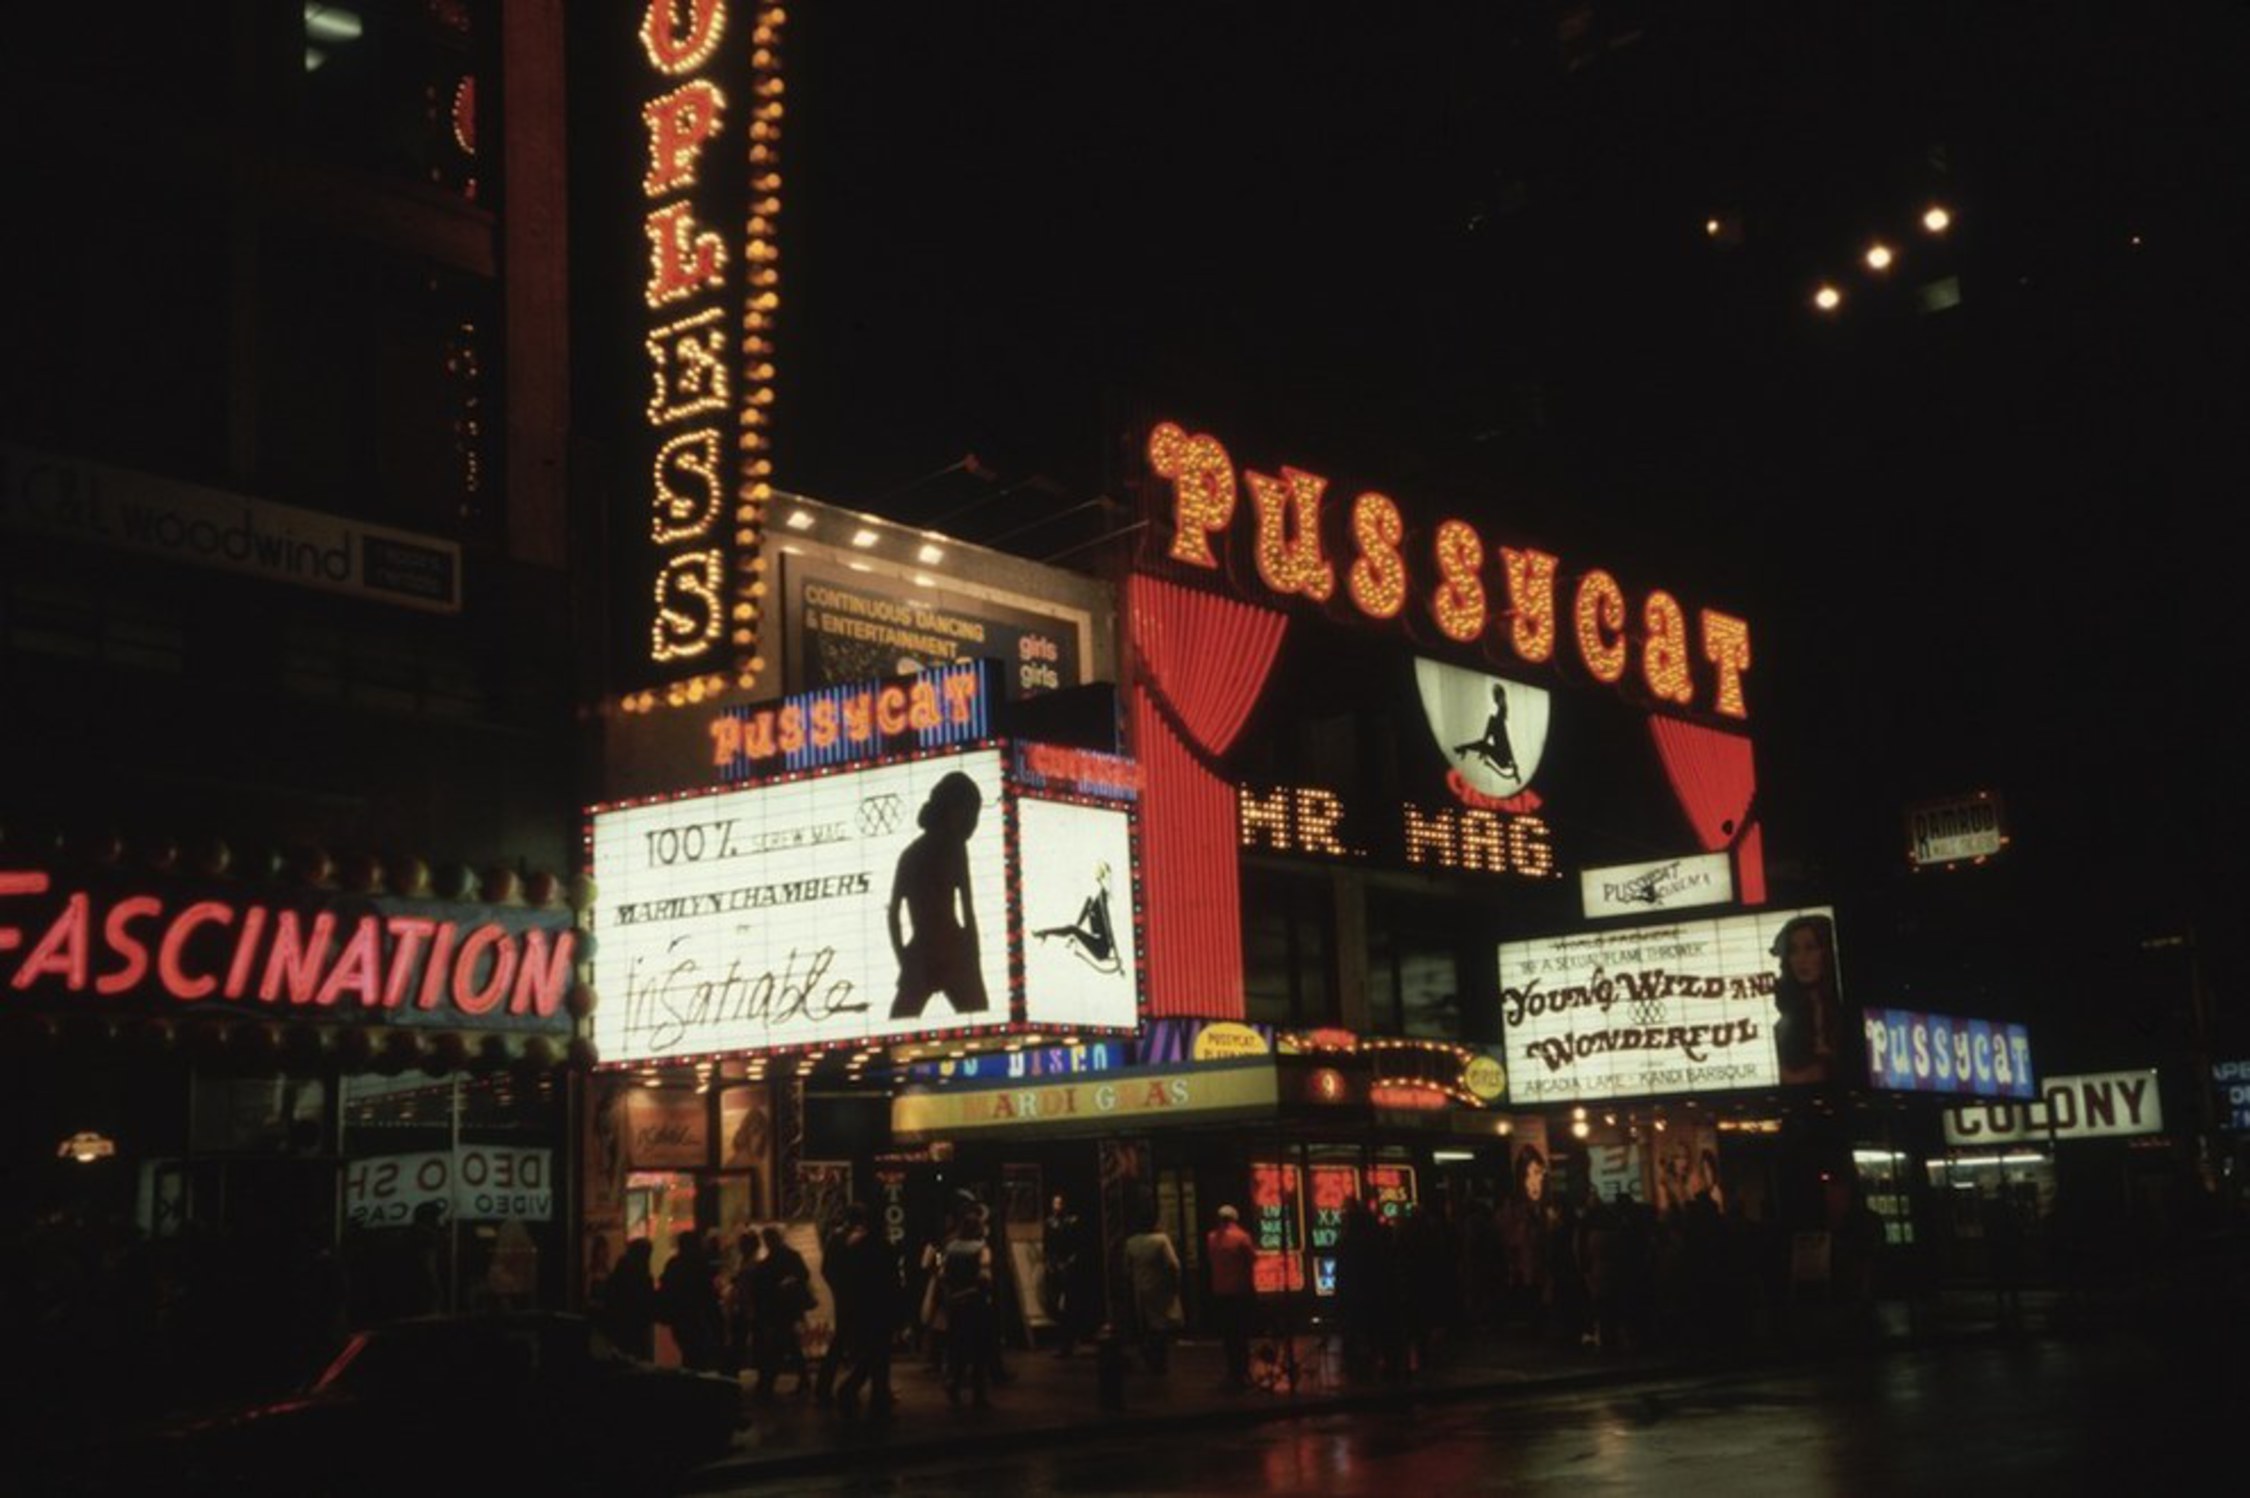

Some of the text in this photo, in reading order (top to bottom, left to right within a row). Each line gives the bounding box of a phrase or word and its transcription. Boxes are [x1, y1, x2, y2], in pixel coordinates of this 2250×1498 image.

[804, 584, 985, 642] CONTINUOUS DANCING
[1018, 634, 1058, 662] girls
[1019, 663, 1059, 690] girls
[614, 871, 873, 927] MARILYN CHAMBERS
[1526, 1017, 1759, 1072] WONDERFUL
[1953, 1078, 2146, 1136] COLONY
